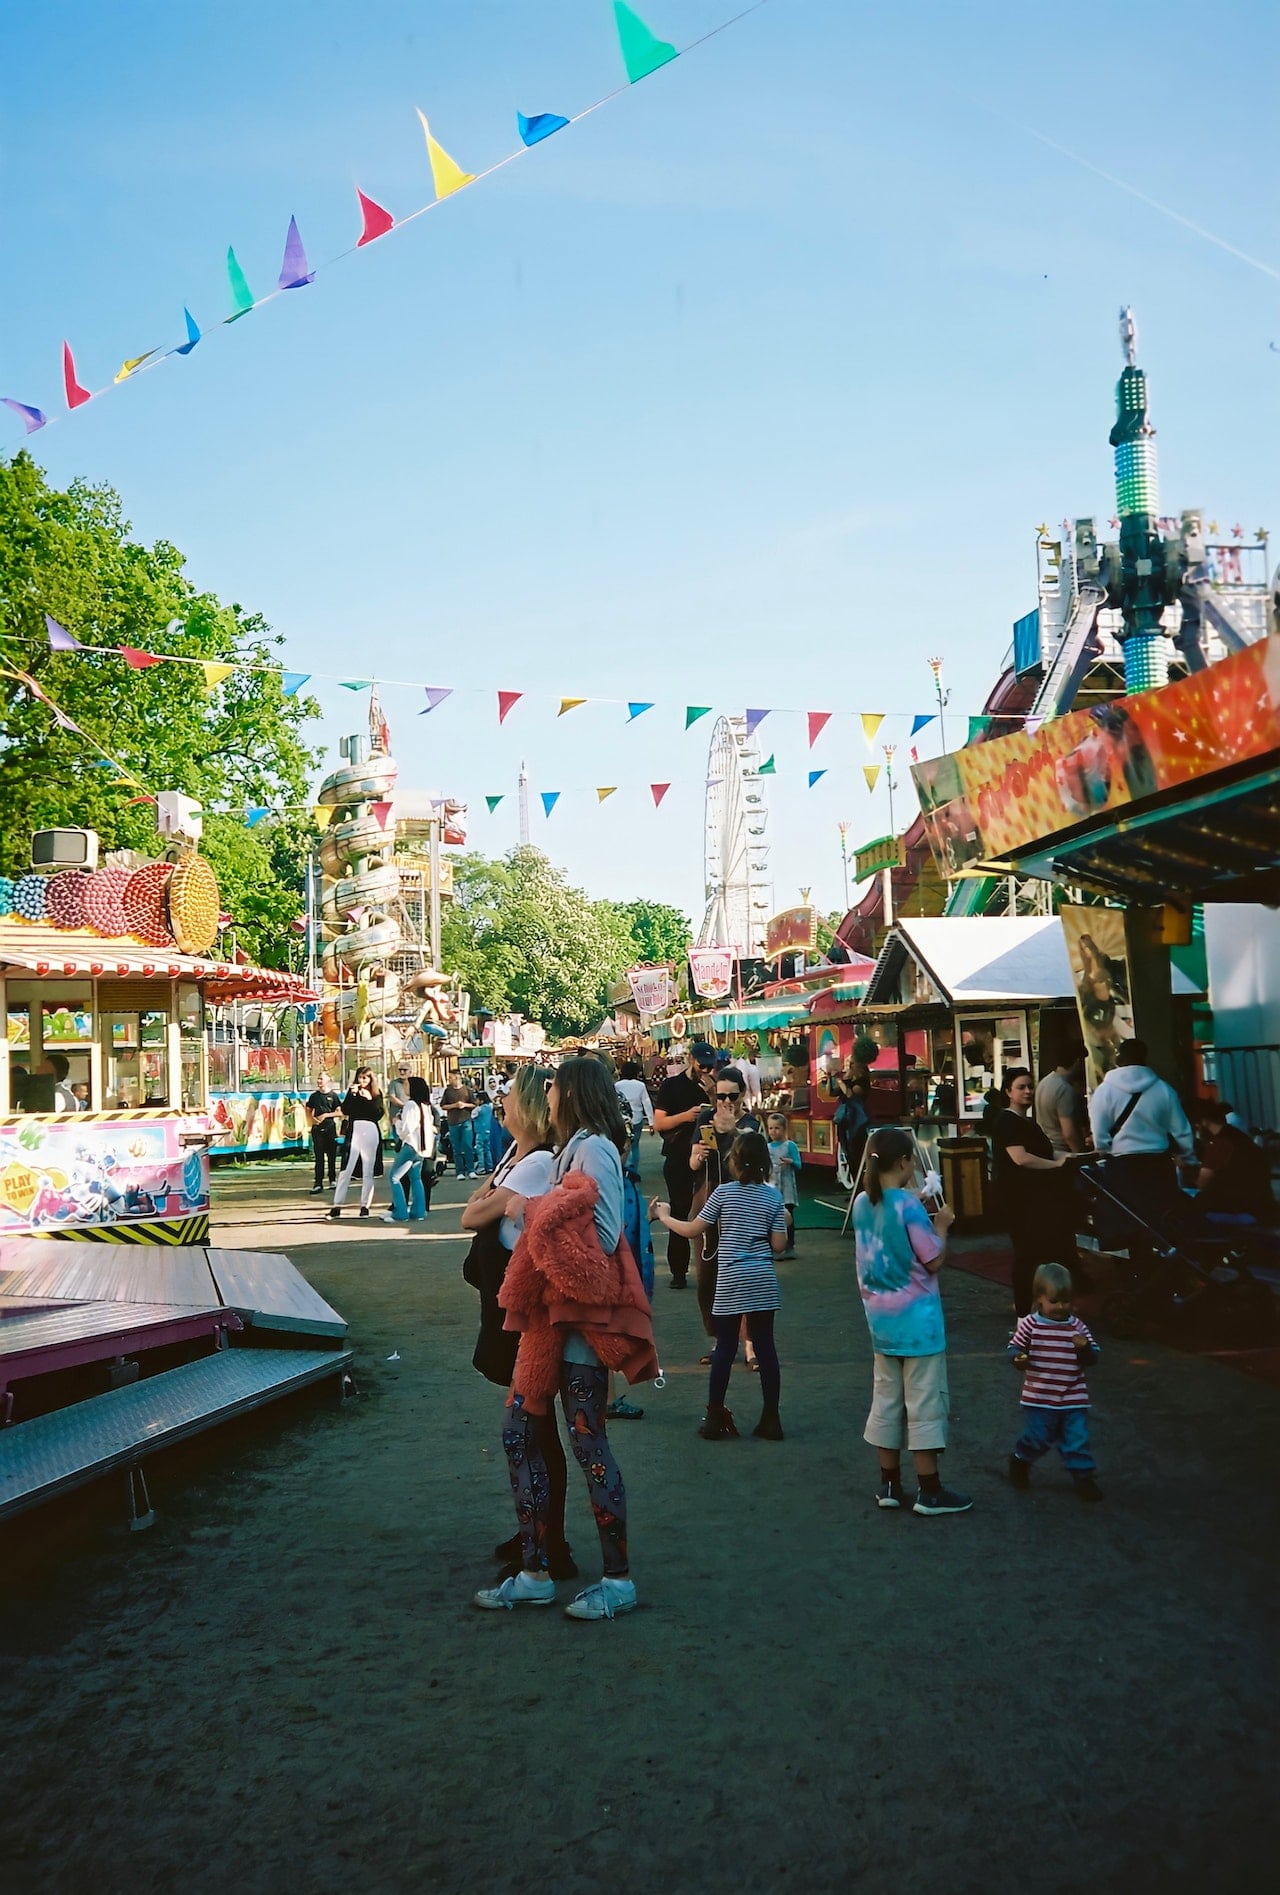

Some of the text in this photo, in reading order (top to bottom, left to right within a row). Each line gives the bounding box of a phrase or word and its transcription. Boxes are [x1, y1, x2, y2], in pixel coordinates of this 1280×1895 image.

[4, 1173, 31, 1191] PLAY
[7, 1187, 34, 1200] TO WIN
